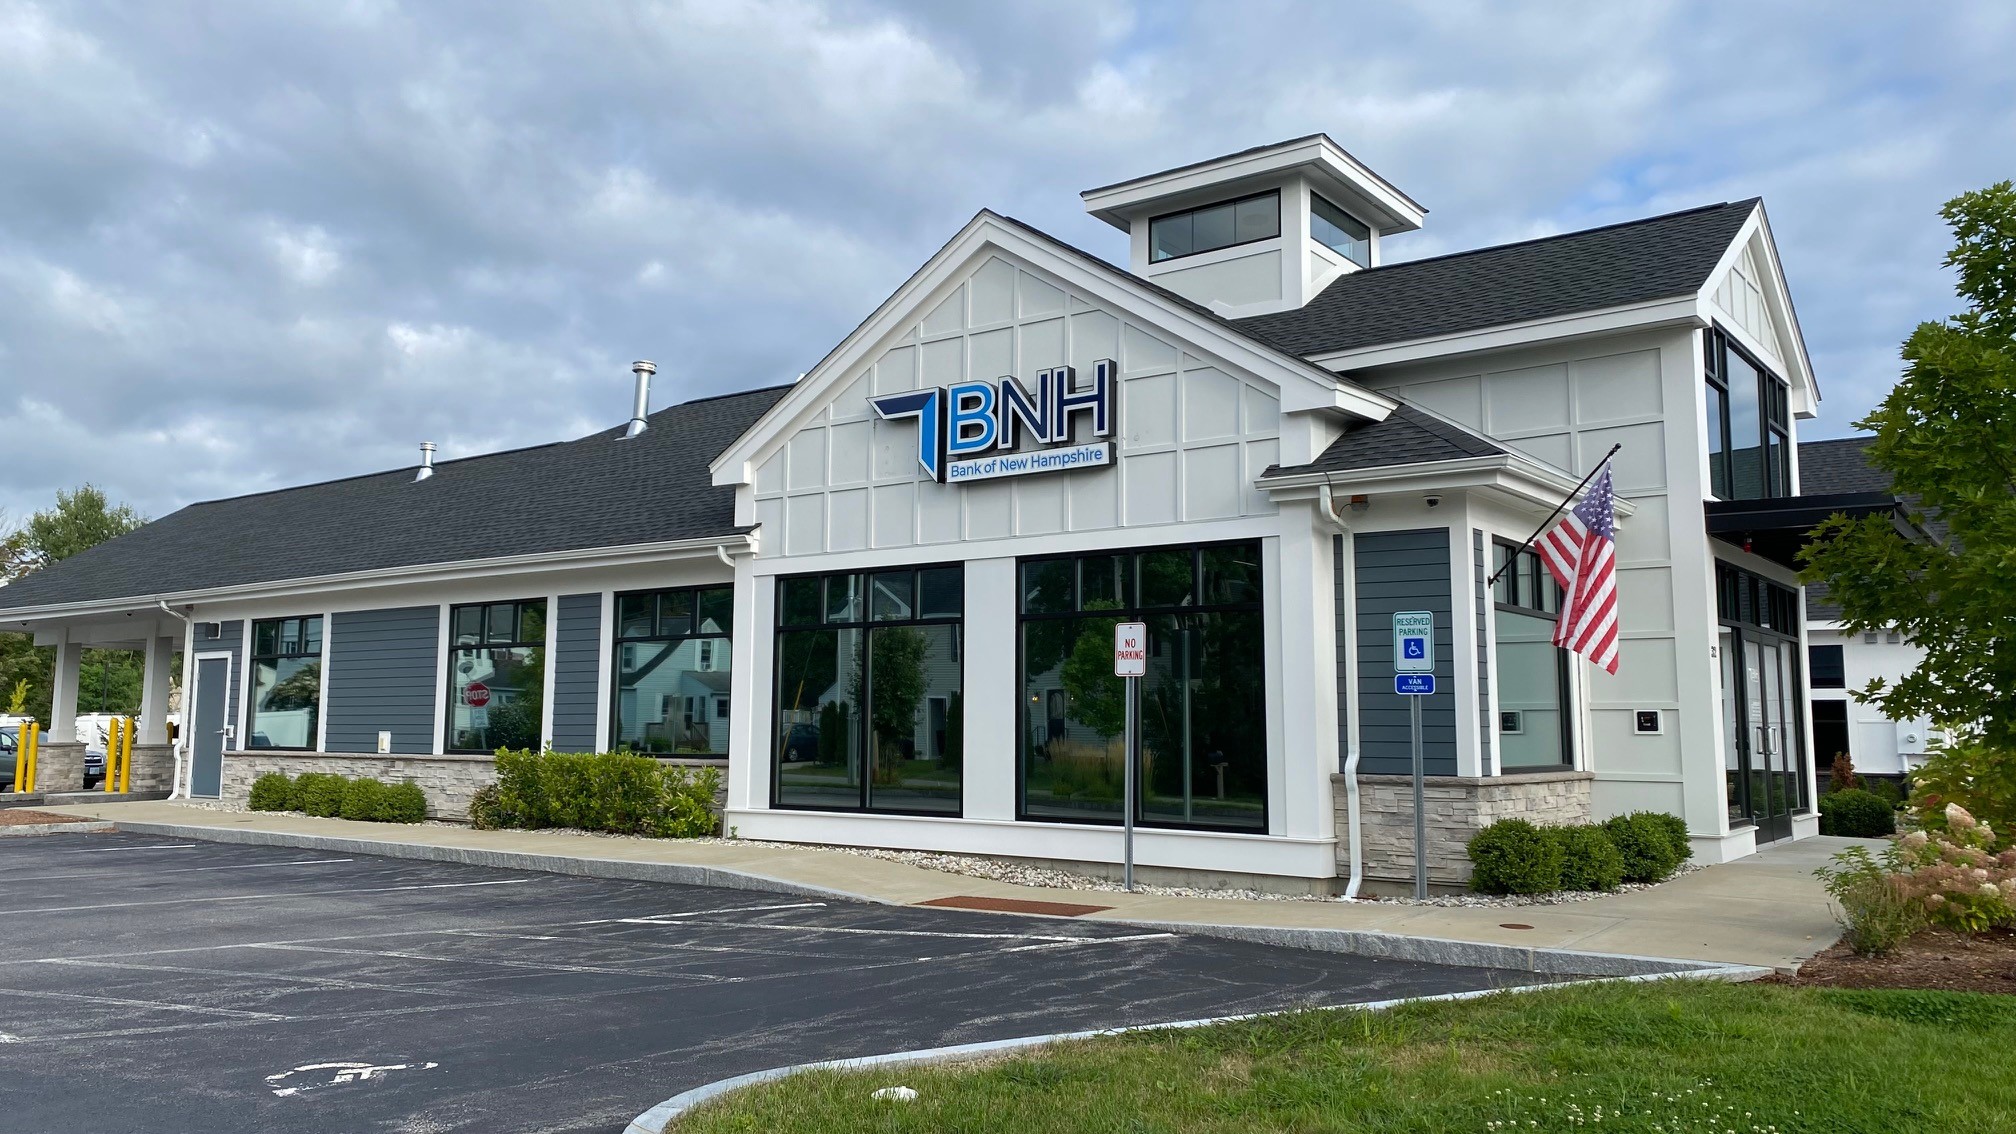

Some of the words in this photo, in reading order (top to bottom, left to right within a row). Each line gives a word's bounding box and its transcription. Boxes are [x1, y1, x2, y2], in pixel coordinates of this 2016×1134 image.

[947, 358, 1110, 455] BNH
[951, 463, 981, 477] Bank
[984, 460, 996, 473] of
[1000, 458, 1027, 471] New
[1031, 448, 1103, 468] Hampshire
[1396, 617, 1430, 626] RESERVED
[1398, 628, 1428, 636] PARKING
[1124, 638, 1136, 648] NO
[1117, 650, 1143, 660] PARKING
